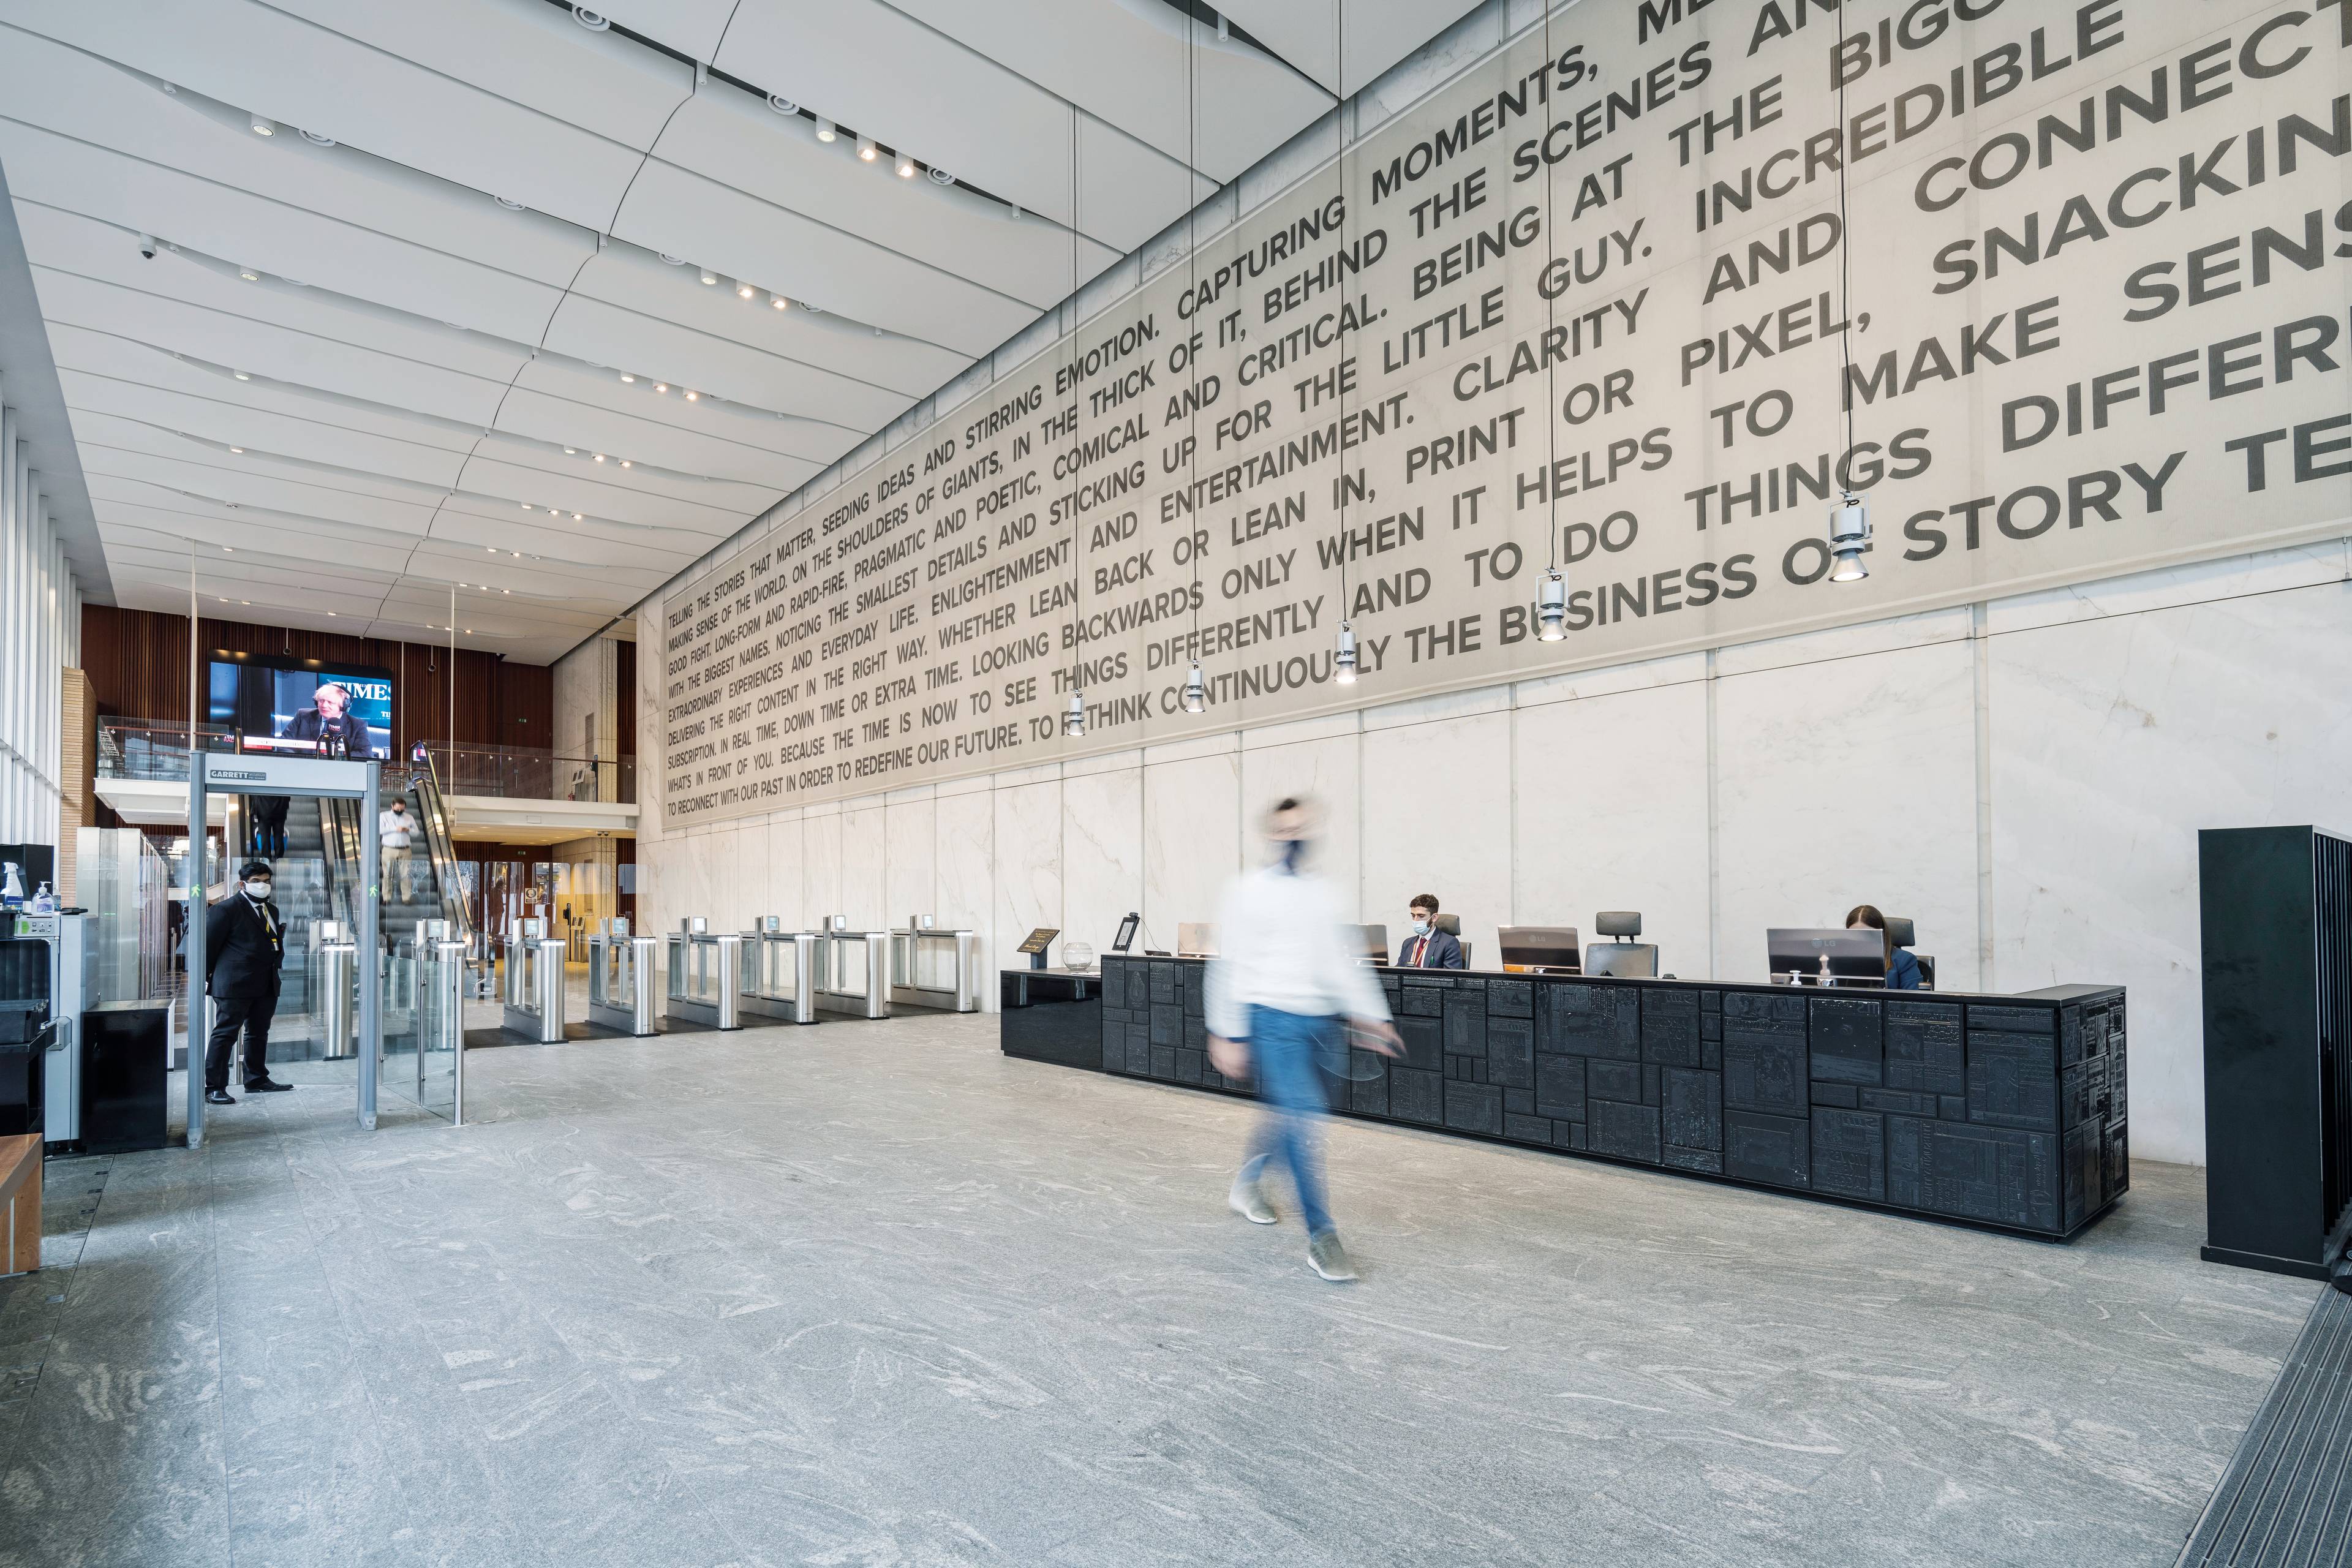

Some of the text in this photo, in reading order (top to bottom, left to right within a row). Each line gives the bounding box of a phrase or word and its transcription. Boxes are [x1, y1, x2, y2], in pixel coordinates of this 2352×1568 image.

[668, 45, 1597, 629] TELLING THE STORIES THAT MATTER, SEEDING IDEAS AND STIRRING EMOTION. CAPTURING MOMENTS,
[668, 41, 1711, 653] MAKING SENSE OF THE WORLD. ON THE SHOULDERS OF GIANTS, IN THE THICK OF IT, BEHIND THE SCENES
[668, 0, 2124, 699] WITH THE BIGGEST NAMES. NOTICING THE SMALLEST DETAILS AND STICKING UP FOR THE LITTLE GUY. INCREDIBLE
[668, 74, 1782, 676] GOOD FIGHT. LONG-FORM AND RAPID-FIRE, PRAGMATIC AND POETIC, COMICAL AND CRITICAL. BEING AT THE
[668, 688, 722, 723] EXTRAORDINARY
[729, 662, 783, 698] EXPERIENCES
[792, 650, 812, 673] AND
[822, 620, 878, 660] EVERYDAY
[890, 605, 918, 633] LIFE.
[932, 537, 1071, 616] ENLIGHTENMENT
[1090, 511, 1137, 552] AND
[1161, 391, 1413, 524] ENTERTAINMENT.
[1453, 288, 1649, 401] CLARITY
[1703, 213, 1841, 305] AND
[668, 721, 704, 746] DELIVERING
[710, 714, 723, 731] THE
[729, 703, 751, 724] RIGHT
[758, 684, 799, 714] CONTENT
[807, 678, 815, 696] IN
[824, 667, 843, 690] THE
[853, 650, 887, 680] RIGHT
[897, 636, 927, 664] WAY.
[939, 603, 1015, 649] WHETHER
[1030, 579, 1076, 617] LEAN
[1095, 549, 1153, 595] BACK
[1174, 530, 1208, 565] OR
[1232, 491, 1305, 546] LEAN
[1333, 468, 1375, 510] IN,
[1407, 407, 1525, 484] PRINT
[1563, 369, 1634, 424] OR
[1682, 287, 1870, 386] PIXEL,
[668, 742, 716, 769] SUBSCRIPTION.
[721, 738, 728, 753] IN
[733, 732, 751, 748] REAL
[756, 722, 778, 741] TIME,
[785, 709, 813, 734] DOWN
[821, 699, 844, 722] TIME
[852, 692, 867, 712] OR
[876, 676, 916, 706] EXTRA
[925, 662, 962, 690] TIME.
[973, 632, 1049, 676] LOOKING
[1062, 581, 1204, 649] BACKWARDS
[1222, 549, 1296, 599] ONLY
[1317, 507, 1423, 570] WHEN
[1453, 486, 1486, 530] IT
[1517, 428, 1672, 510] HELPS
[1711, 390, 1793, 448] TO
[1842, 296, 2059, 404] MAKE
[668, 306, 2352, 793] WHAT'S IN FRONT OF YOU. BECAUSE THE TIME IS NOW TO SEE THINGS DIFFERENTLY AND TO DO THINGS DIFFER
[211, 771, 248, 779] GARRETT
[668, 802, 676, 816] TO
[679, 793, 718, 814] RECONNECT
[721, 788, 738, 805] WITH
[741, 783, 758, 801] OUR
[761, 777, 783, 797] PAST
[787, 774, 795, 792] IN
[799, 766, 832, 789] ORDER
[837, 762, 851, 781] TO
[856, 747, 912, 777] REDEFINE
[918, 739, 949, 764] OUR
[956, 723, 1022, 757] FUTURE.
[1029, 715, 1053, 741] TO
[1061, 692, 1152, 736] RTHINK
[1404, 614, 1480, 663] THE
[1903, 451, 2187, 561] STORY
